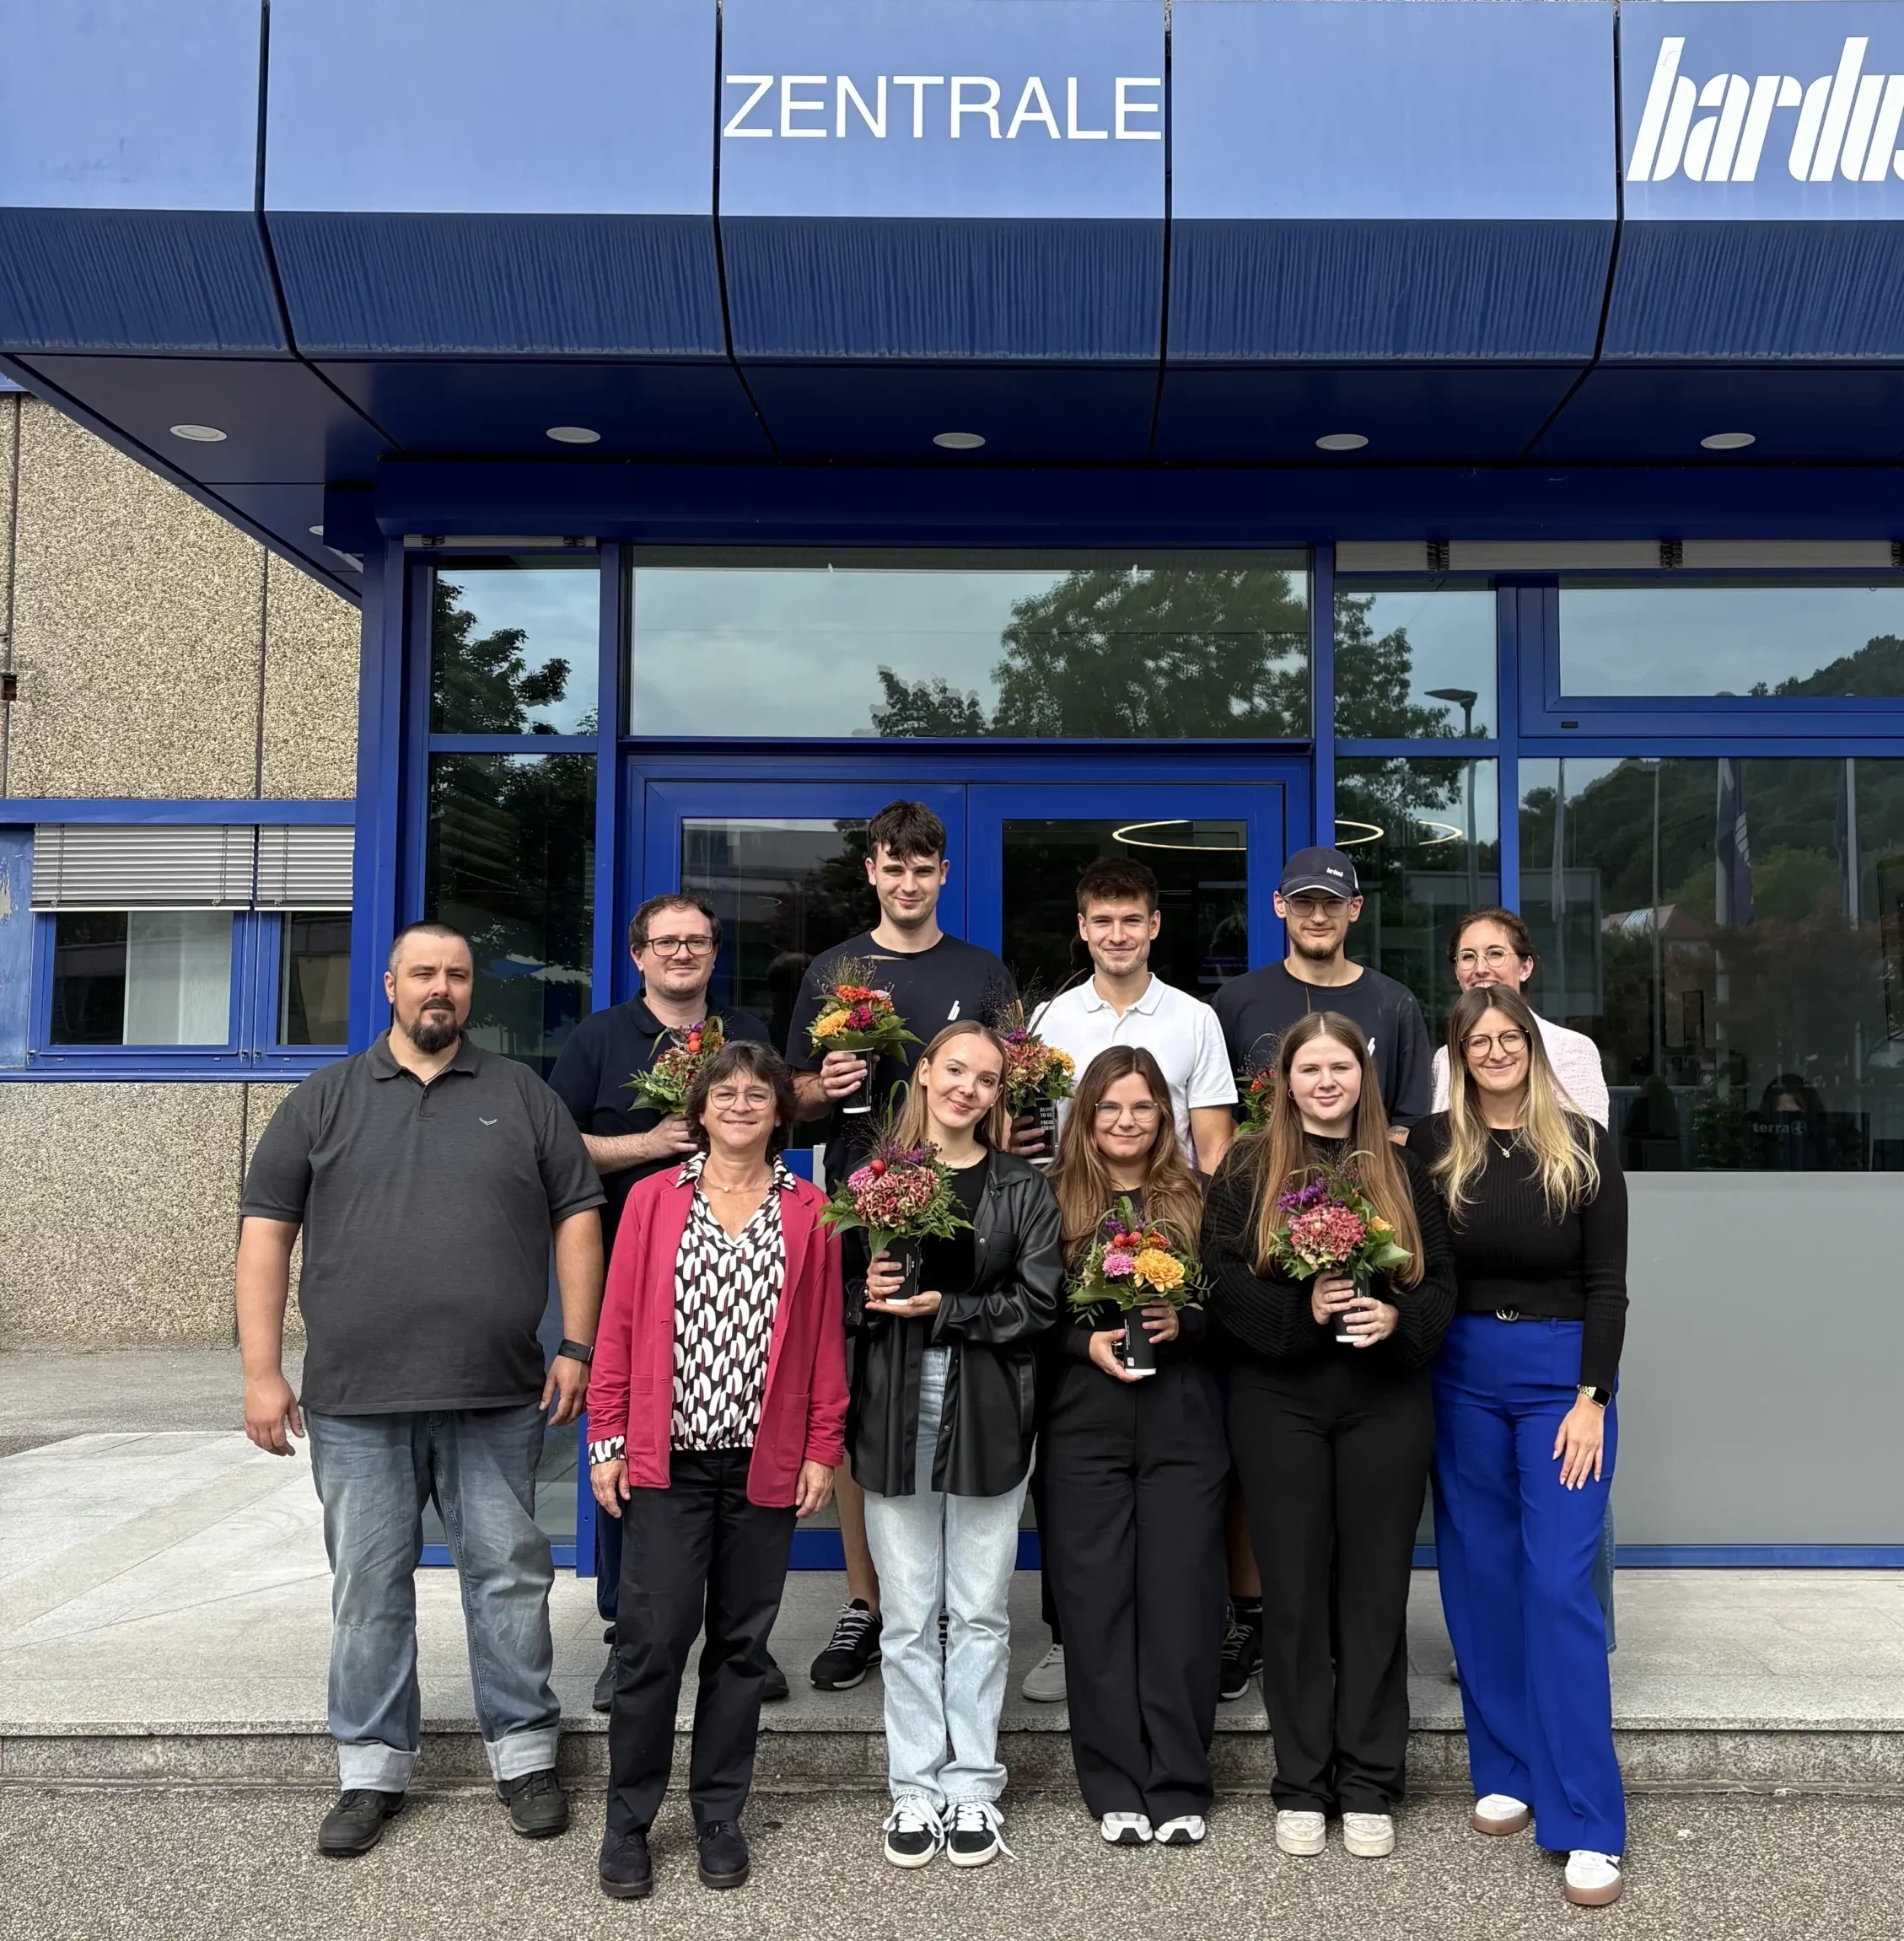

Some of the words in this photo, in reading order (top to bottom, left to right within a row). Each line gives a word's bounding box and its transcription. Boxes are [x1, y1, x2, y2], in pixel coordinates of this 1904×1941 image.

[723, 75, 1161, 140] ZENTRALE
[1626, 36, 1904, 181] bardu
[1752, 1122, 1789, 1133] terra
